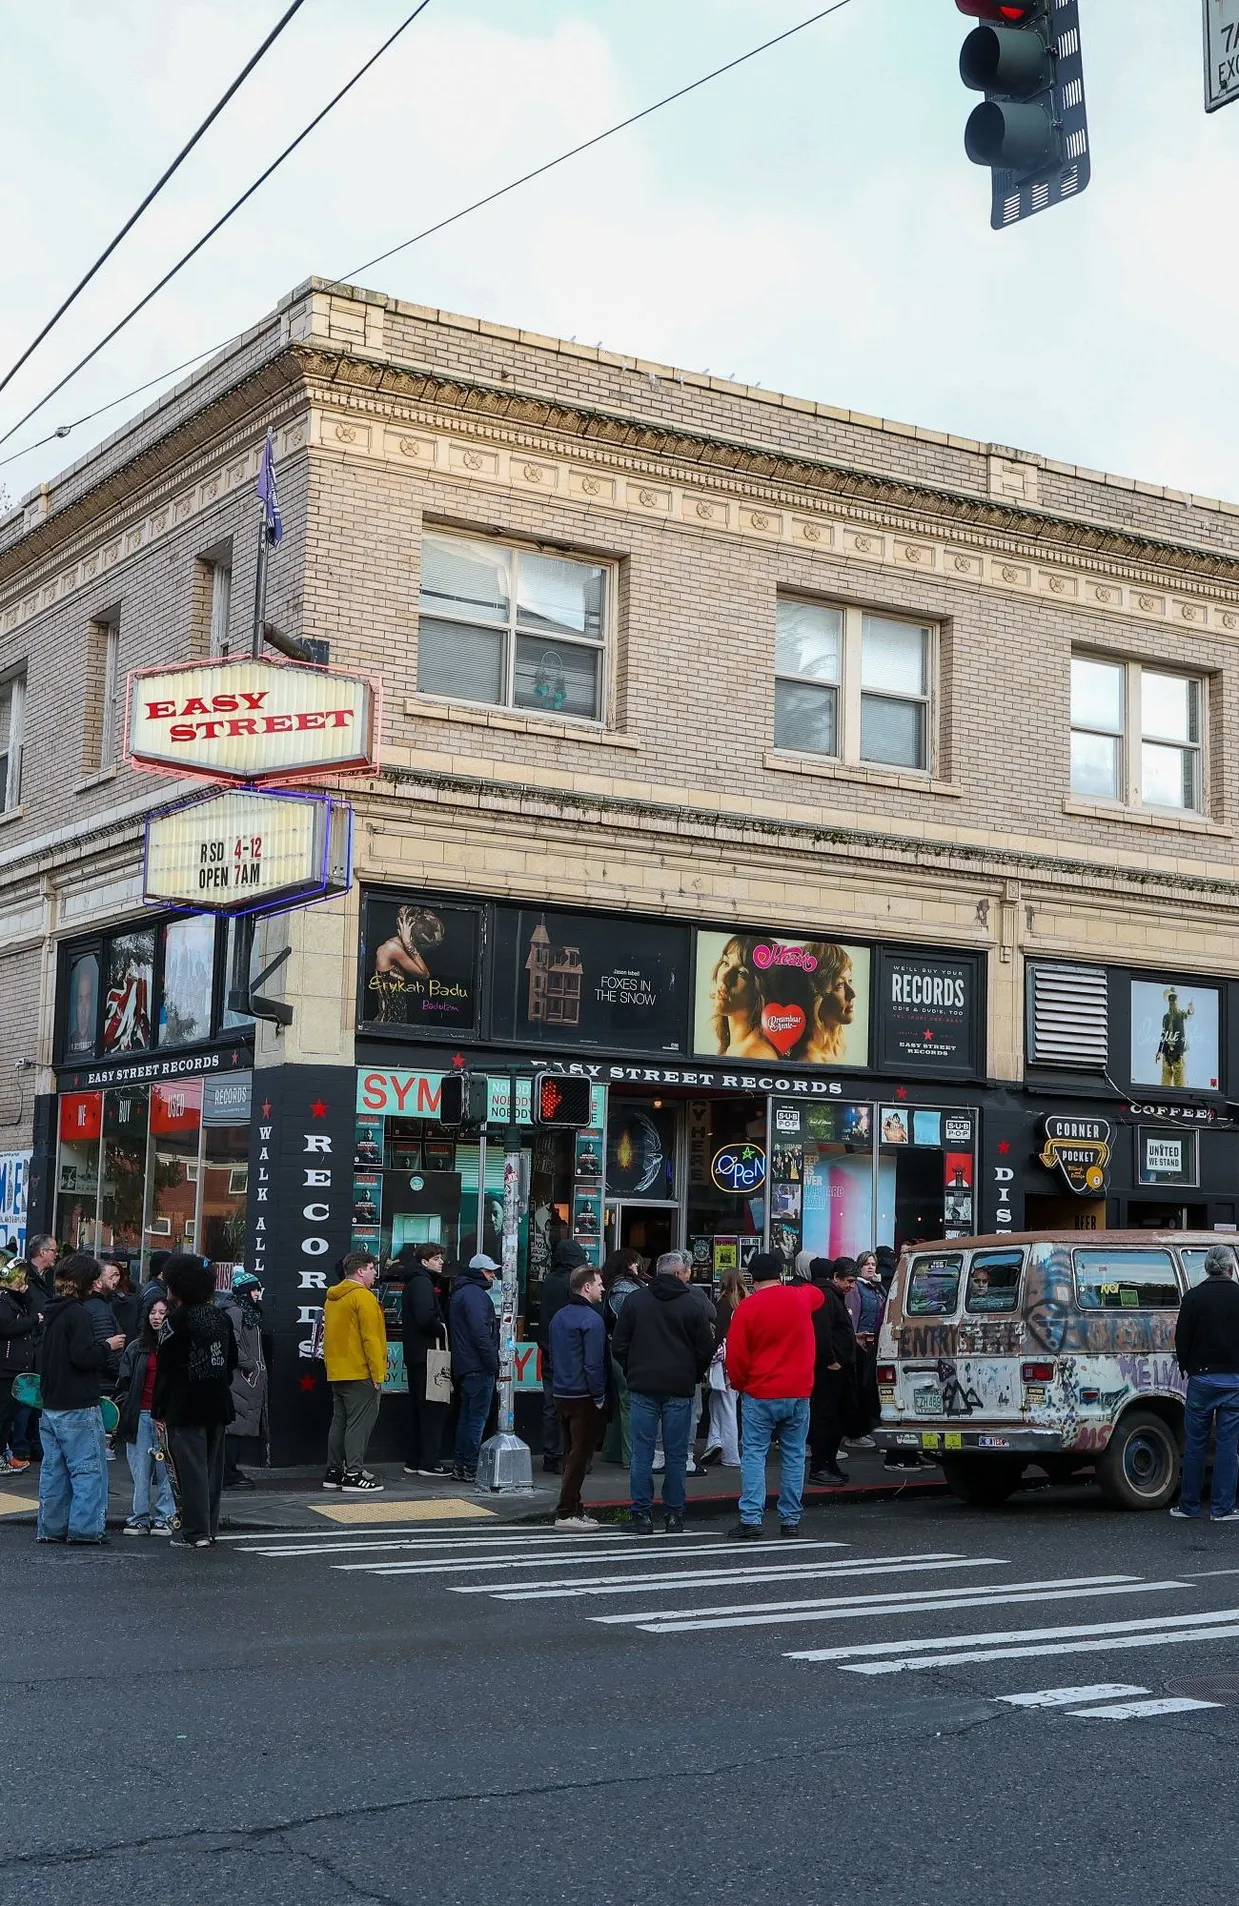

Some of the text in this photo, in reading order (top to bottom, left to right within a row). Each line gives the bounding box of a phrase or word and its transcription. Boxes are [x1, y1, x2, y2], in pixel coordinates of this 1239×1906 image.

[145, 691, 270, 720] EASY
[169, 709, 354, 743] STREET
[200, 837, 262, 864] RSD 4-12
[199, 863, 261, 889] OPEN 7AM
[368, 975, 469, 998] Erykah Badu
[601, 976, 651, 992] FOXES IN
[892, 973, 965, 1007] RECORDS
[594, 989, 656, 1006] THE SNOW
[907, 1048, 948, 1056] RECORDS
[923, 1043, 957, 1051] STREET
[88, 1054, 219, 1085] EASY STREET RECORDS
[610, 1066, 714, 1086] STREET
[722, 1075, 843, 1095] RECORDS
[214, 1086, 247, 1106] RECORDS
[363, 1073, 441, 1112] SYM
[77, 1104, 86, 1127] WE
[118, 1099, 132, 1123] BUY
[167, 1093, 185, 1118] USED
[1130, 1104, 1208, 1119] COFFEE
[1056, 1122, 1100, 1139] CORNER
[1062, 1150, 1095, 1163] POCKET
[1149, 1144, 1179, 1157] UNITED
[1149, 1158, 1179, 1167] WE STAND
[257, 1126, 273, 1202] WALK
[994, 1167, 1014, 1234] DIS
[255, 1217, 266, 1271] ALL
